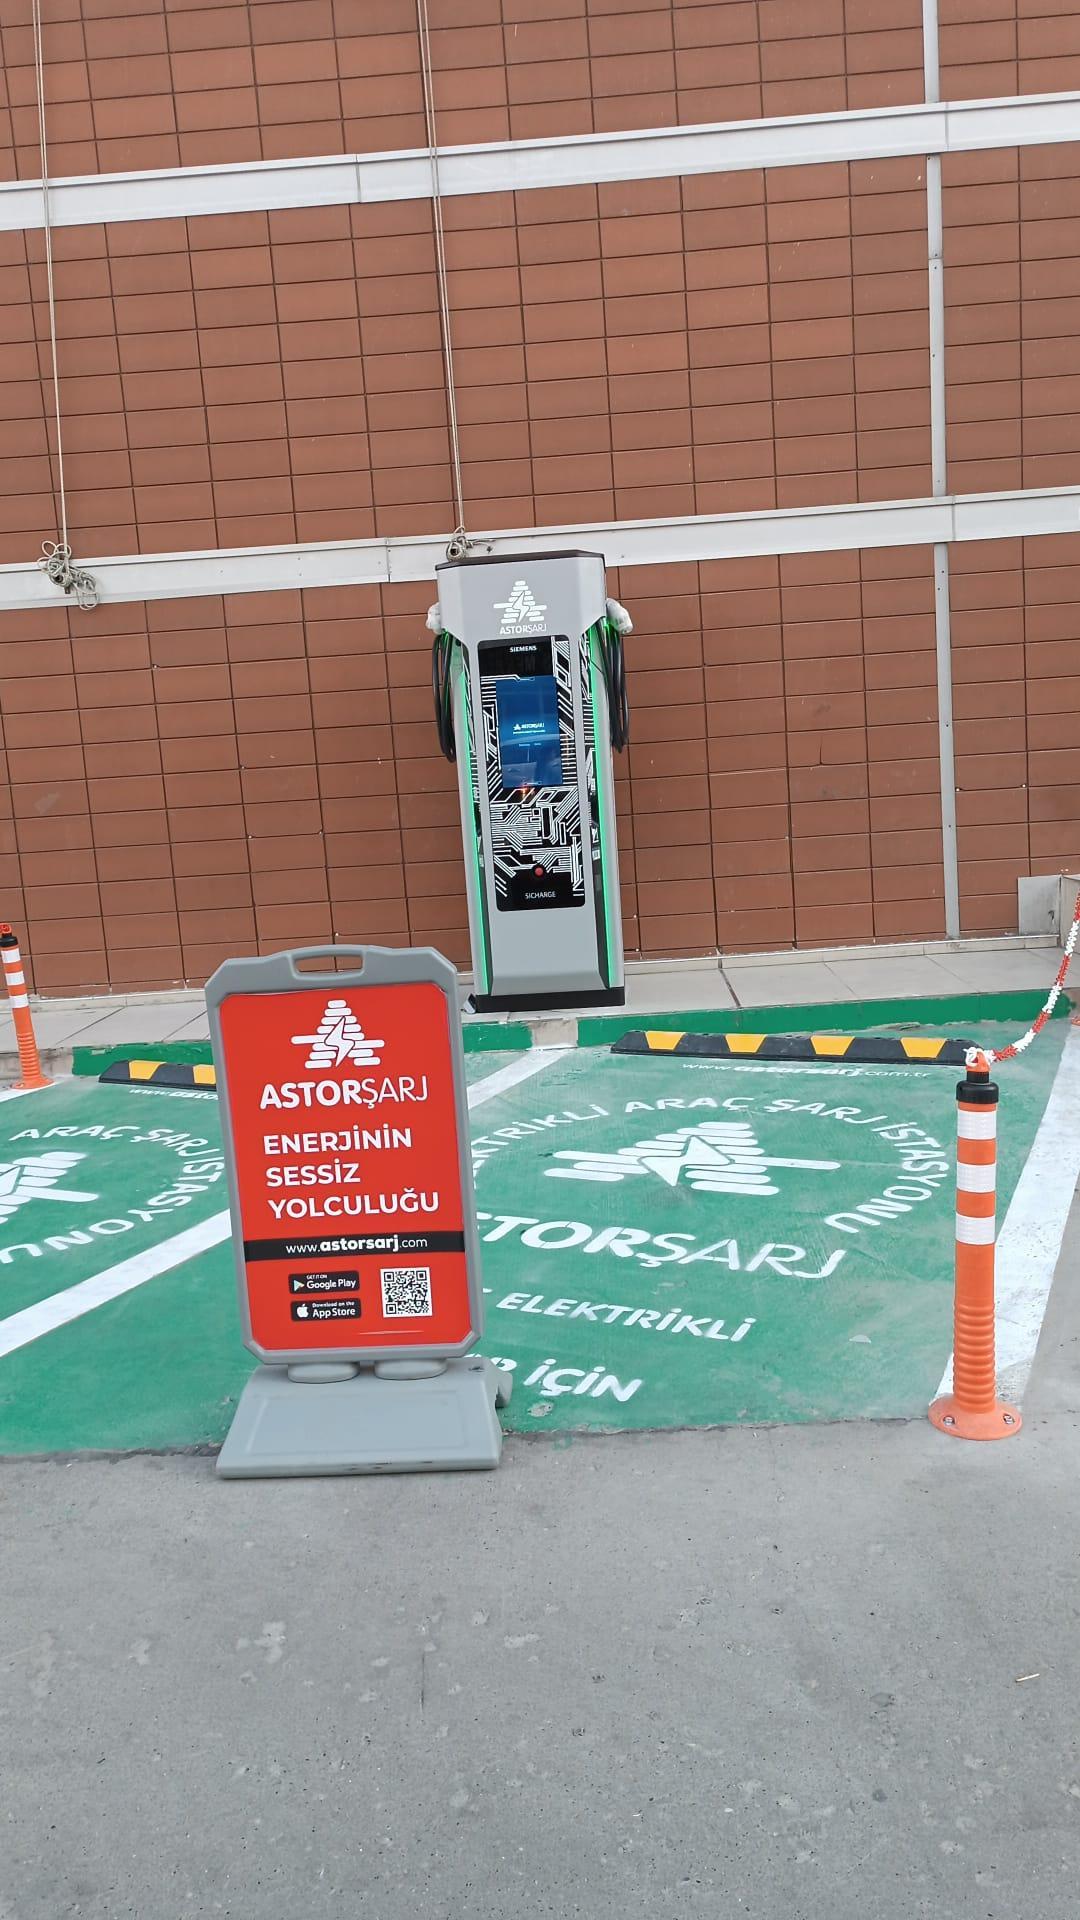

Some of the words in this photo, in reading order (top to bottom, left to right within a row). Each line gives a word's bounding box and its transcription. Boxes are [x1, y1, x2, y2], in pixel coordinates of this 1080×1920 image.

[500, 624, 547, 635] ASTORŞARJ
[509, 645, 537, 653] SIEMENS
[524, 891, 556, 899] SICHARGE
[260, 1075, 429, 1109] ASTORŞARJ
[625, 1097, 755, 1113] ARAÇ
[764, 1099, 888, 1124] ŞARJ
[9, 1125, 141, 1141] ARAÇ
[130, 1129, 221, 1157] ŞARJ
[263, 1123, 412, 1155] ENERJİNİN
[265, 1158, 361, 1187] SESSİZ
[824, 1121, 950, 1233] İSTASYONU
[268, 1187, 440, 1219] YOLCULUĞU
[286, 1234, 428, 1254] www.astorsarj.com
[476, 1212, 848, 1279] TORŞARJ
[306, 1280, 337, 1290] Google
[338, 1278, 356, 1289] Play
[313, 1309, 331, 1318] App
[332, 1307, 356, 1317] Store
[496, 1292, 756, 1342] ELEKTRİKLİ
[523, 1358, 643, 1402] İÇİN
